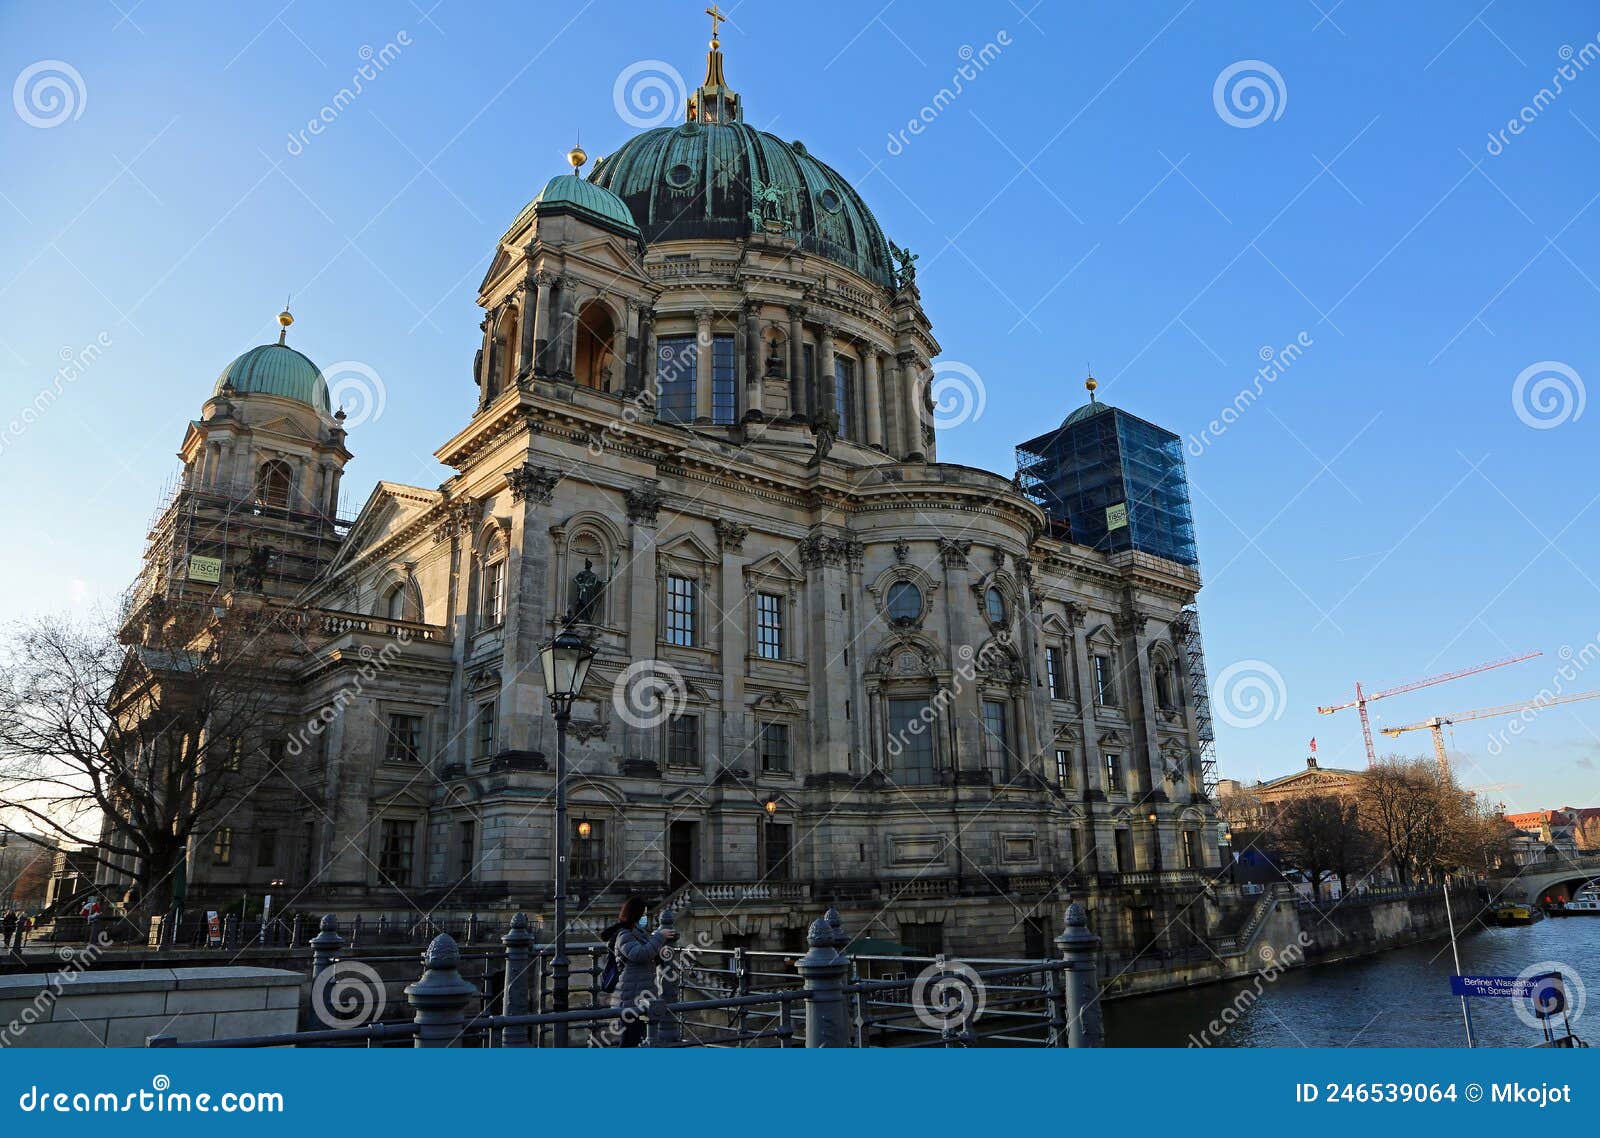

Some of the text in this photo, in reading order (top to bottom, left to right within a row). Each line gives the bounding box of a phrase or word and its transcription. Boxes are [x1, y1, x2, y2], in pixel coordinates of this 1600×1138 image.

[191, 562, 220, 574] TISCH
[1464, 978, 1493, 986] Berliner
[1488, 987, 1528, 995] Spreefahrt
